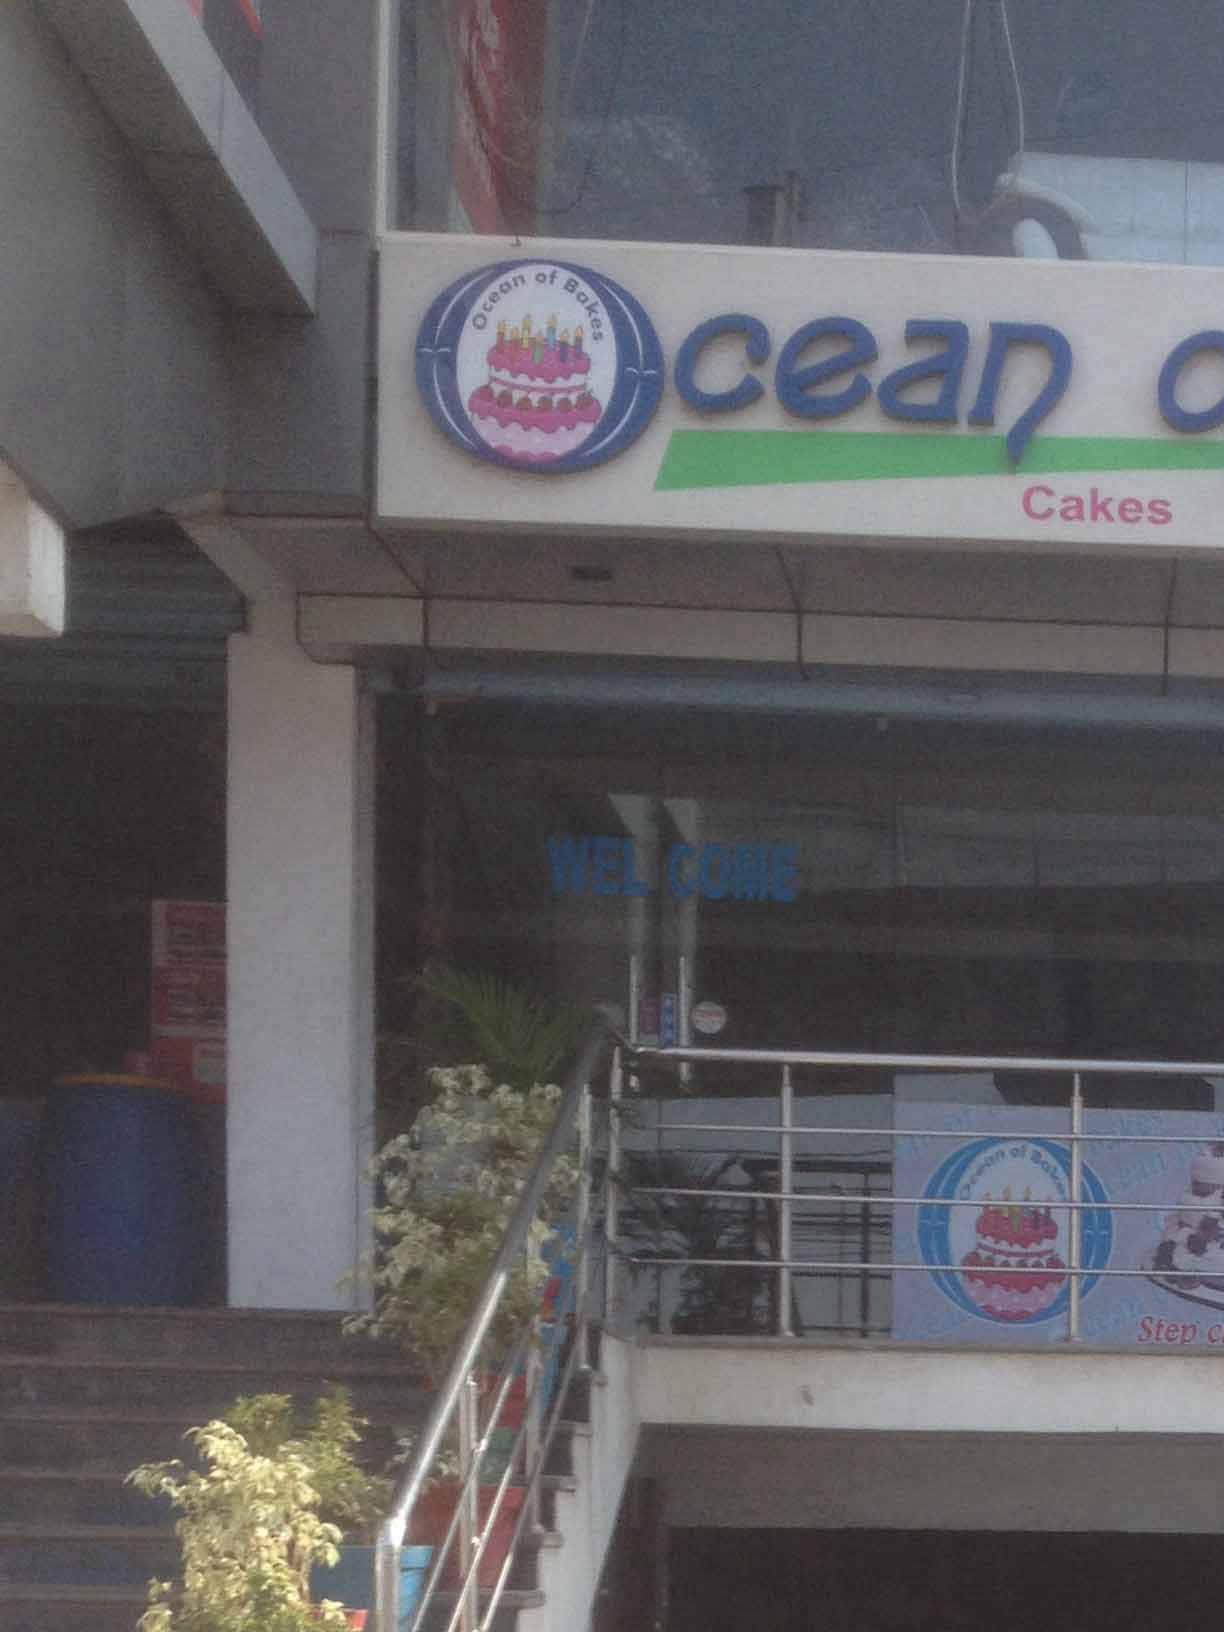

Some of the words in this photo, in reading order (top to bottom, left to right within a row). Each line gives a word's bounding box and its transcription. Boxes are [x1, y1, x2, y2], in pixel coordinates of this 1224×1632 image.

[472, 272, 526, 331] Ocean
[535, 269, 559, 286] of
[563, 277, 604, 342] Bakes
[1021, 484, 1174, 527] Cakes
[1137, 1315, 1198, 1345] Step
